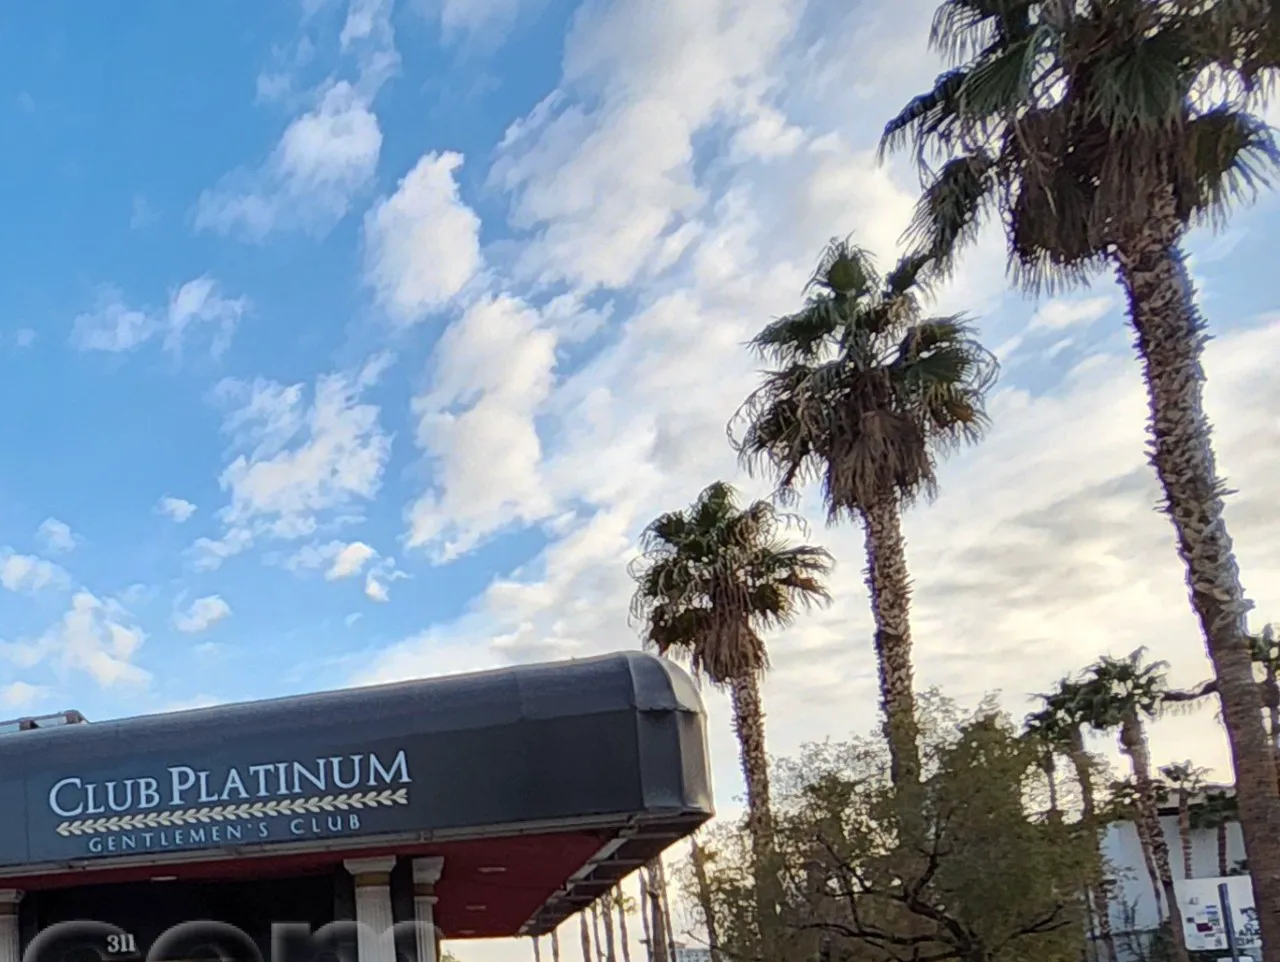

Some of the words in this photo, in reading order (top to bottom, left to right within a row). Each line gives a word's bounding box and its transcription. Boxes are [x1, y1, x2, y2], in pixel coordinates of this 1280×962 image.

[49, 777, 160, 817] CLUB
[167, 750, 412, 806] PLATINUM
[89, 822, 268, 853] GENTLEMEN'S
[290, 813, 361, 837] CLUB
[107, 934, 136, 953] 311
